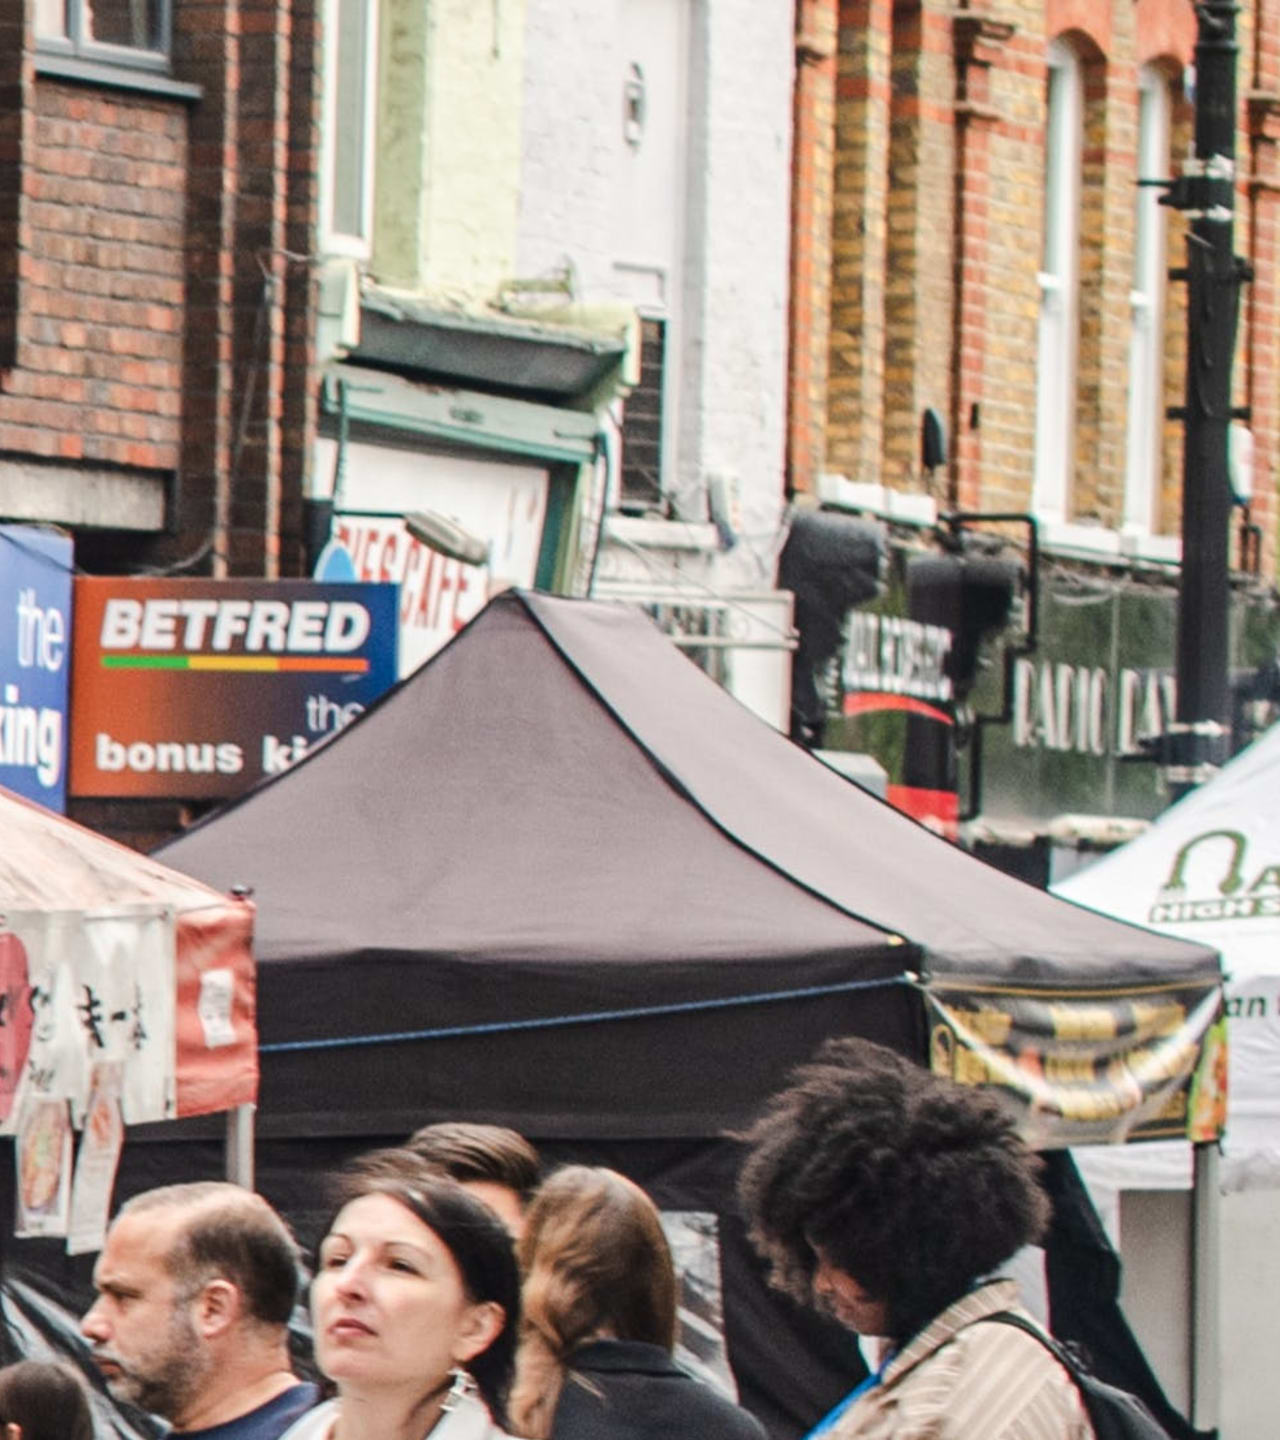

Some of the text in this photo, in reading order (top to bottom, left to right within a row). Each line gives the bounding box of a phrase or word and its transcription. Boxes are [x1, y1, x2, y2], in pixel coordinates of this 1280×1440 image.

[16, 588, 65, 672] the
[100, 598, 372, 653] BETFRED
[95, 732, 244, 773] bonus
